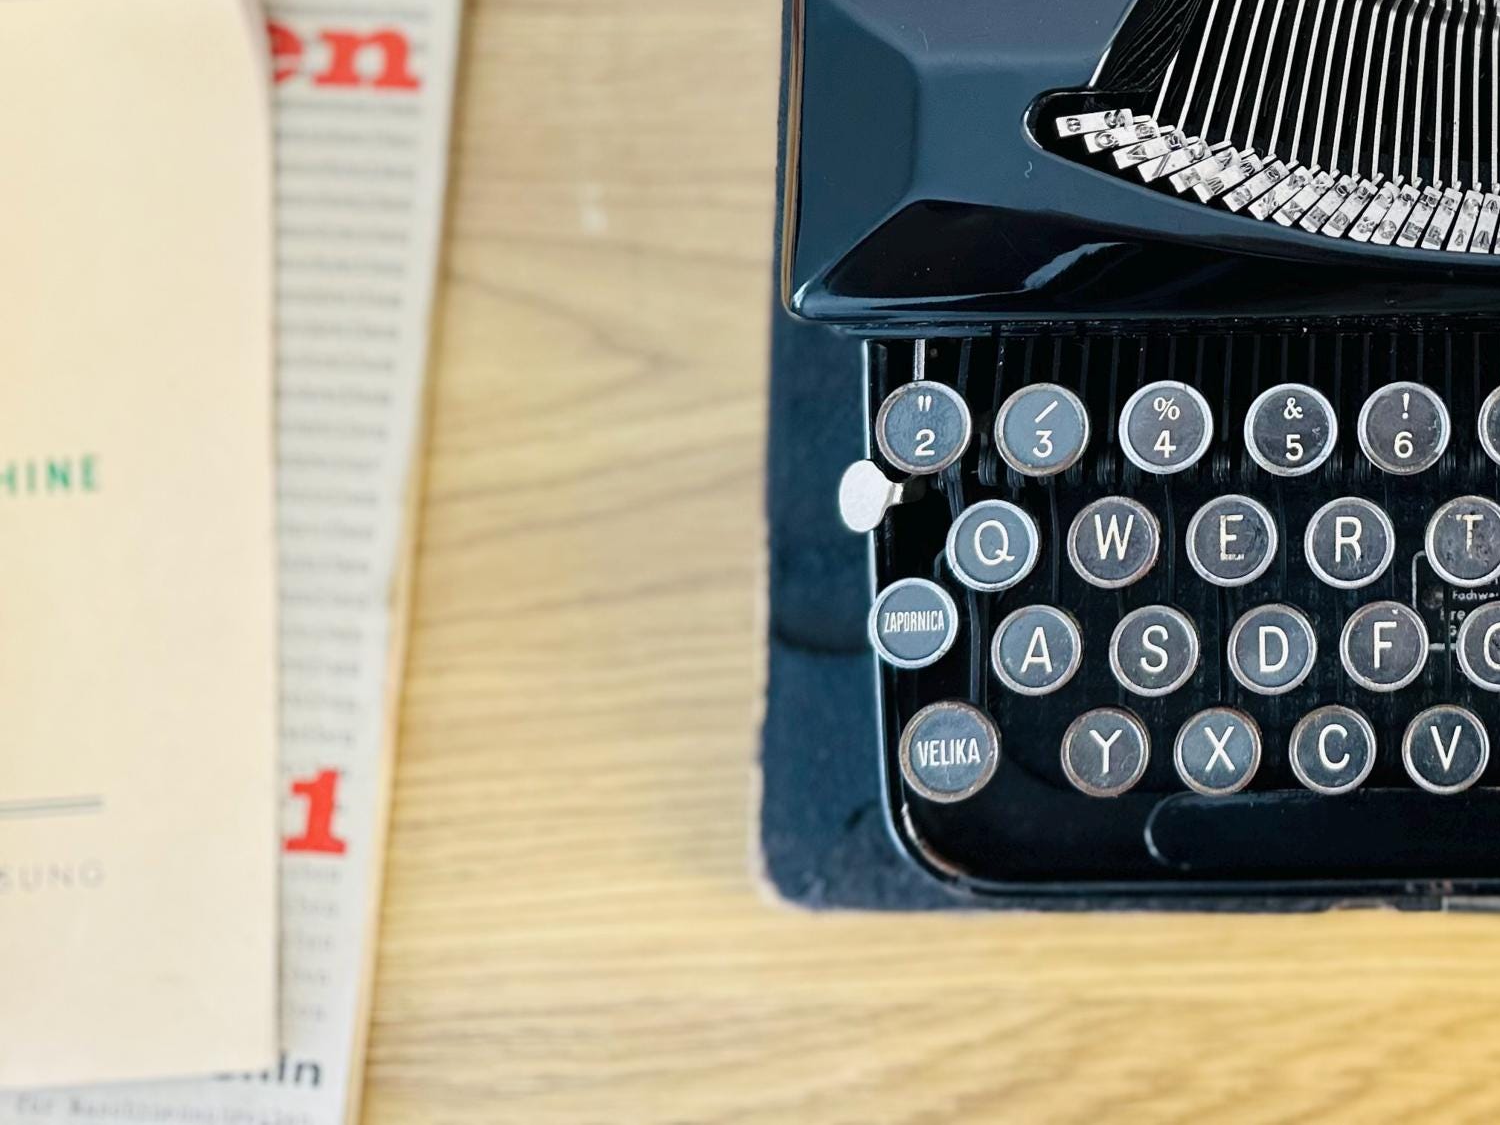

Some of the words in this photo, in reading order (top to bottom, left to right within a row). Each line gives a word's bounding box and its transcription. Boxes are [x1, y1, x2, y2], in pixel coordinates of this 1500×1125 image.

[915, 429, 935, 456] 2
[1033, 431, 1052, 457] 3
[1154, 431, 1176, 458] 4
[1286, 435, 1303, 460] 5
[1394, 432, 1413, 458] 6
[974, 520, 1014, 565] Q
[1094, 514, 1135, 560] W
[1220, 515, 1244, 560] E
[1336, 517, 1361, 562] R
[1455, 515, 1483, 553] T
[884, 610, 945, 633] ZAPORNICA
[1021, 627, 1052, 672] A
[1141, 625, 1168, 672] S
[1260, 626, 1288, 672] D
[1374, 622, 1396, 668] F
[917, 738, 980, 767] VELIKA
[1090, 730, 1122, 774] Y
[1205, 727, 1235, 771] X
[1319, 724, 1349, 770] C
[1431, 726, 1461, 770] V
[283, 770, 347, 855] 1
